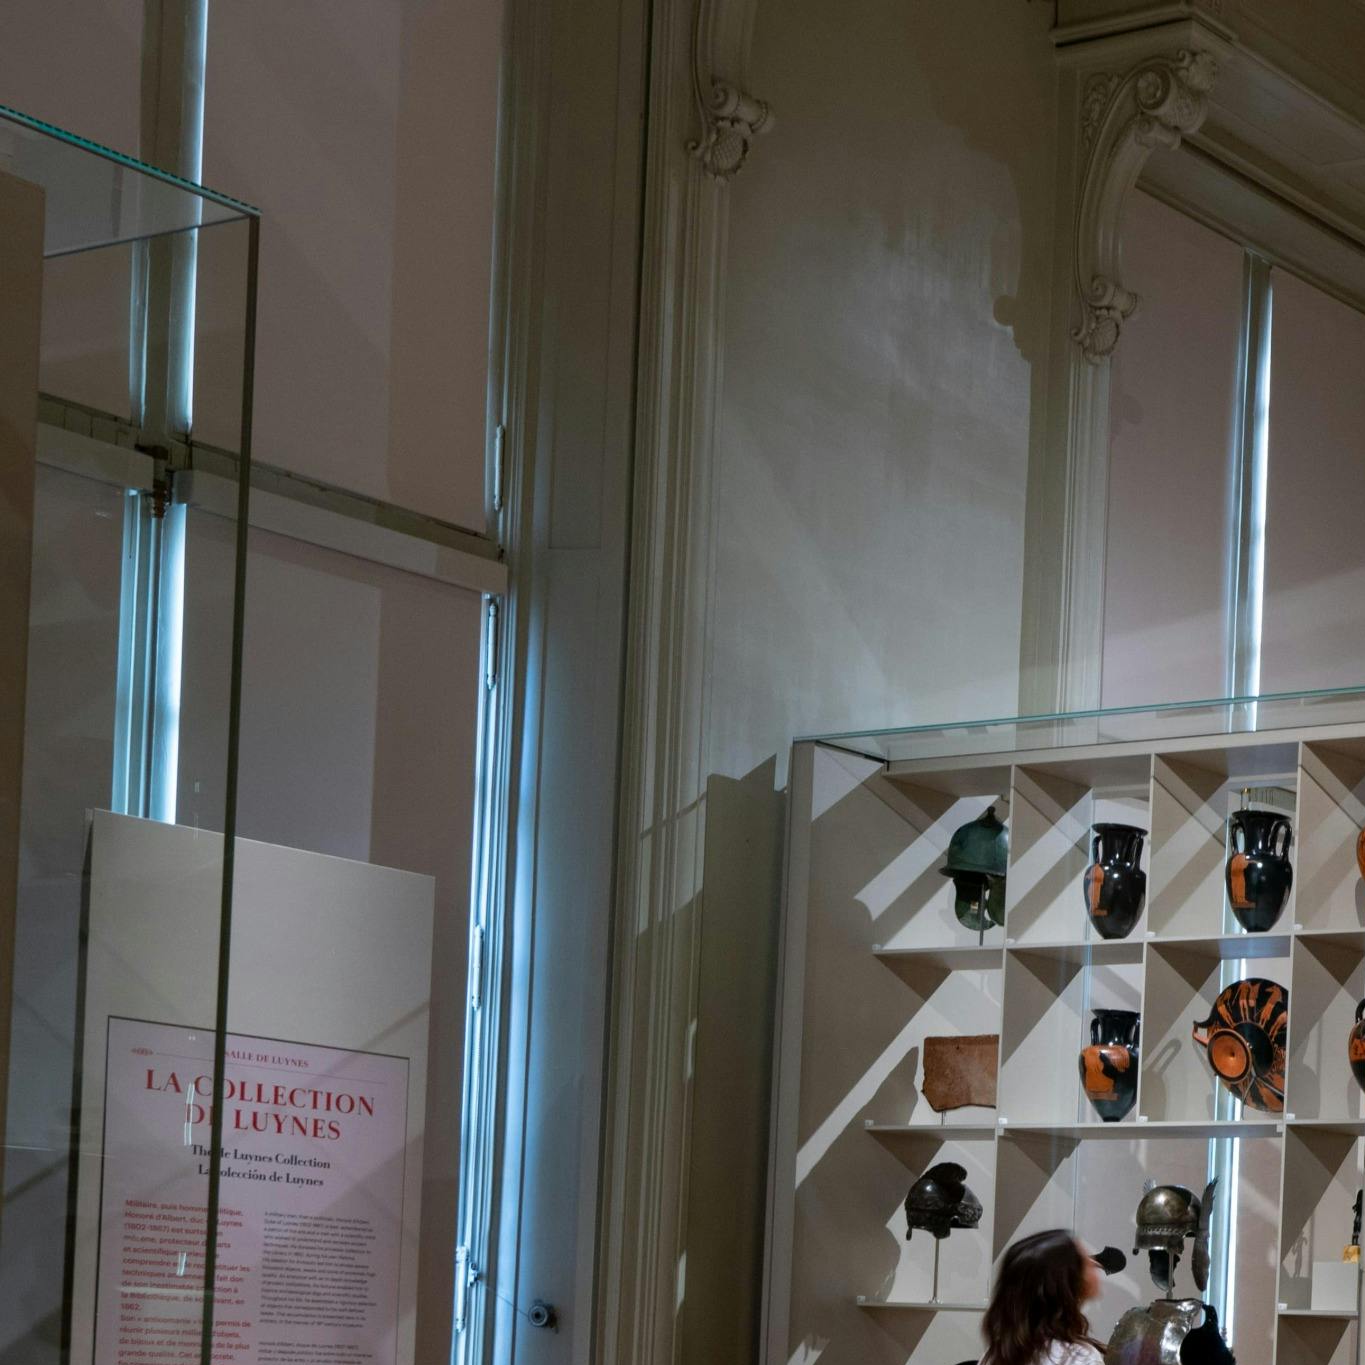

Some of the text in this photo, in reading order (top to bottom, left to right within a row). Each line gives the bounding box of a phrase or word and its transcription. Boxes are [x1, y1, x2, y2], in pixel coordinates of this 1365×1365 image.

[256, 1053, 270, 1063] DE
[272, 1055, 309, 1068] LUYNES
[145, 1069, 375, 1117] LA COLLECTION
[234, 1108, 341, 1141] LUYNES
[234, 1148, 273, 1165] Luynes
[275, 1152, 331, 1169] Collection
[219, 1166, 267, 1181] olección
[269, 1171, 283, 1182] de
[286, 1172, 324, 1189] Luynes
